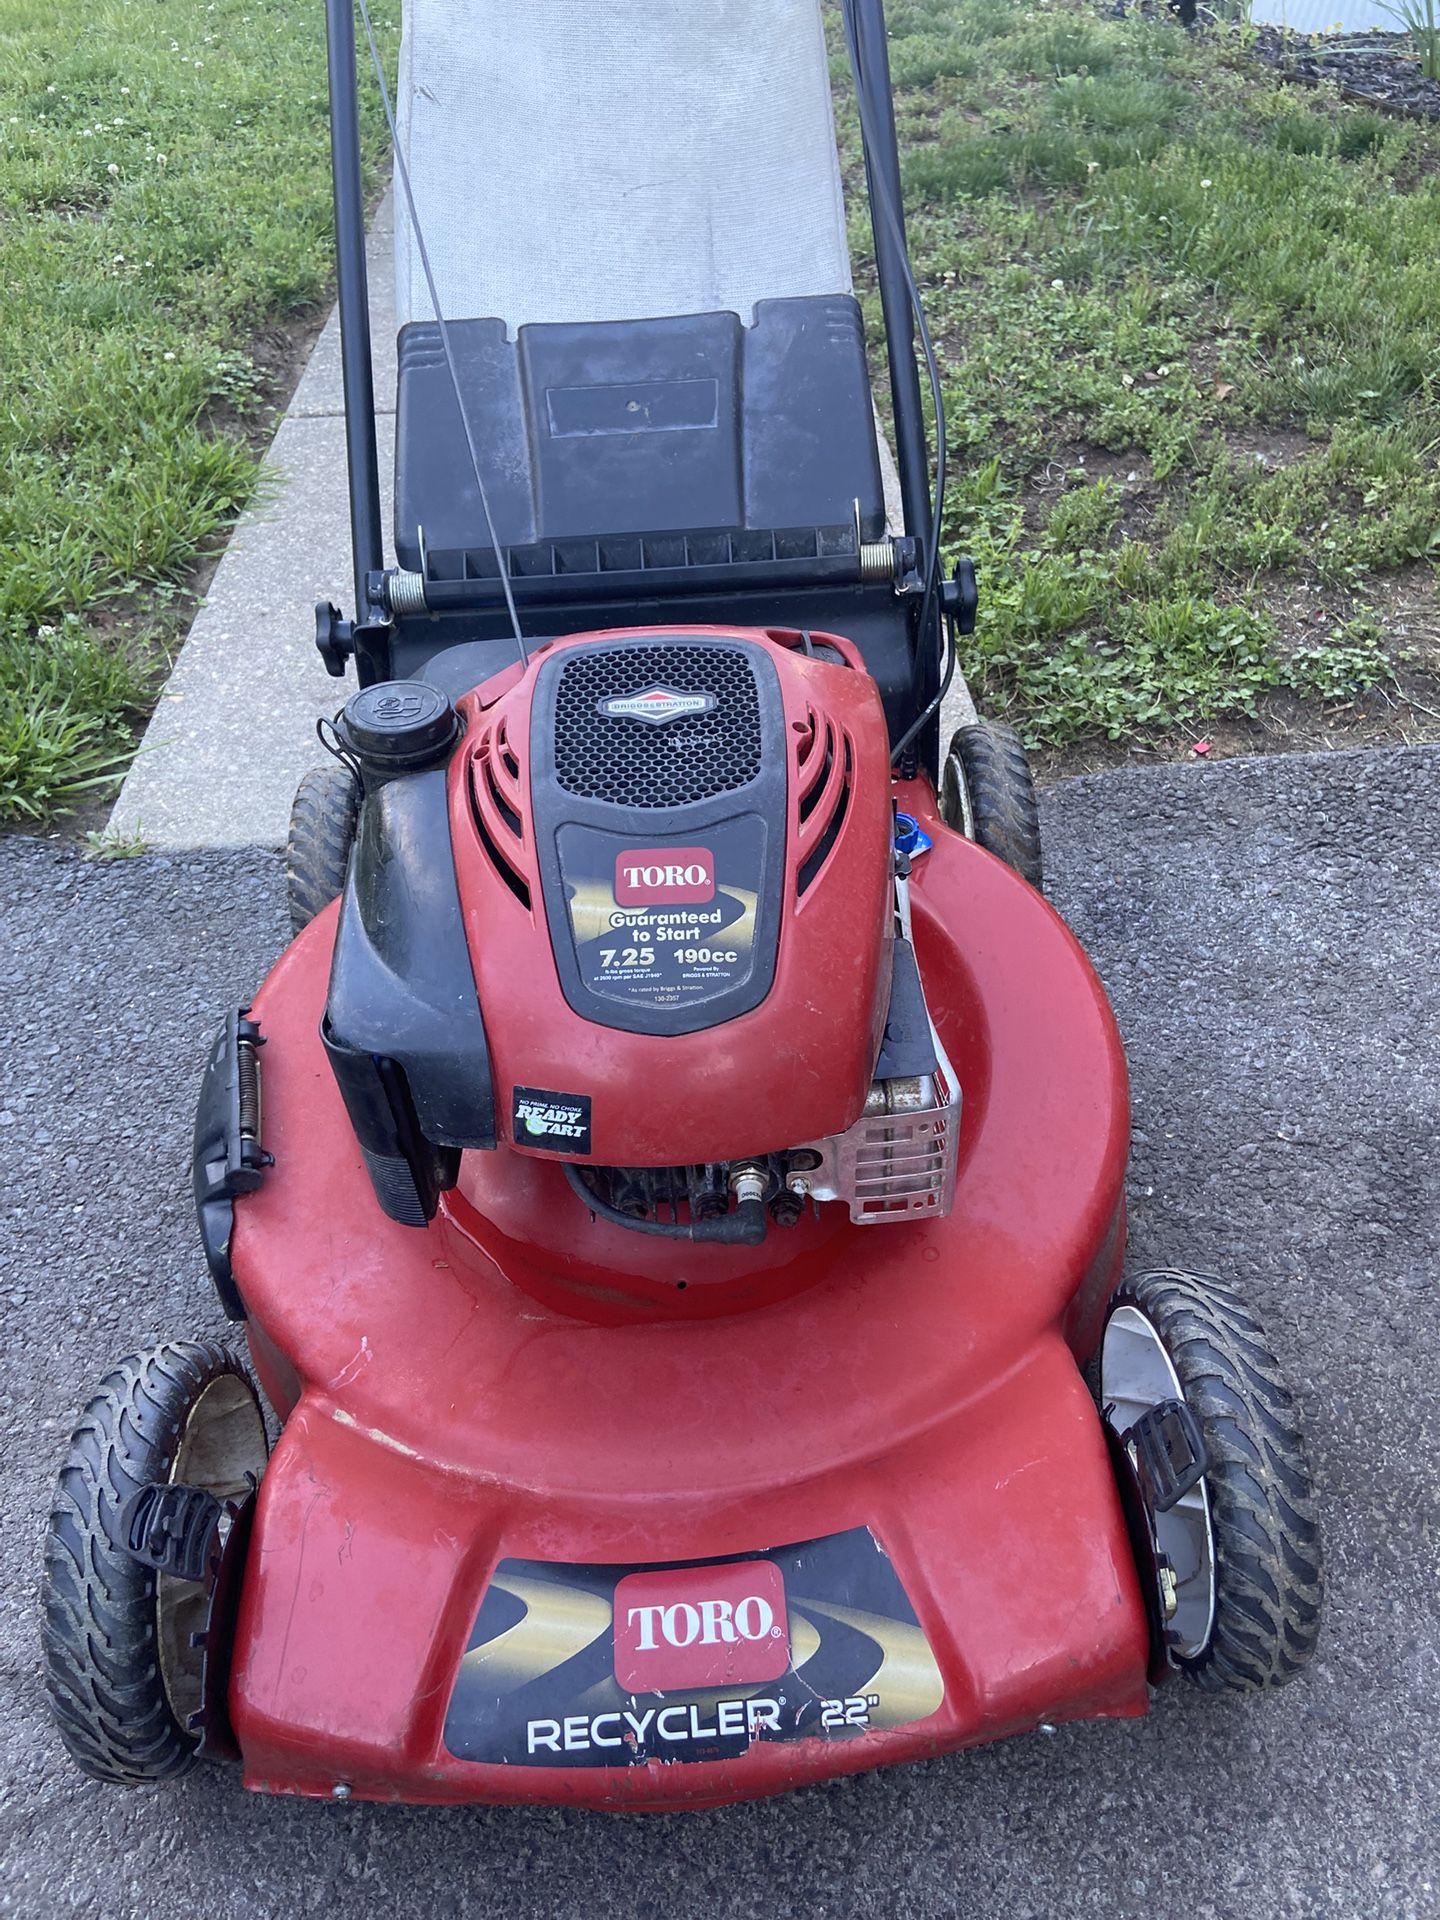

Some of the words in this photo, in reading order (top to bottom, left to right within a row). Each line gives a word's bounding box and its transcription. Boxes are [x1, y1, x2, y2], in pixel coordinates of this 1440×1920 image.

[623, 864, 707, 888] TORO
[610, 908, 722, 927] Guaranteed
[632, 929, 650, 942] to
[656, 927, 701, 941] Start
[599, 947, 656, 967] 7.25
[673, 948, 738, 964] 190cc
[515, 1105, 582, 1124] READY
[628, 1596, 774, 1651] TORO
[527, 1699, 783, 1754] RECYCLER
